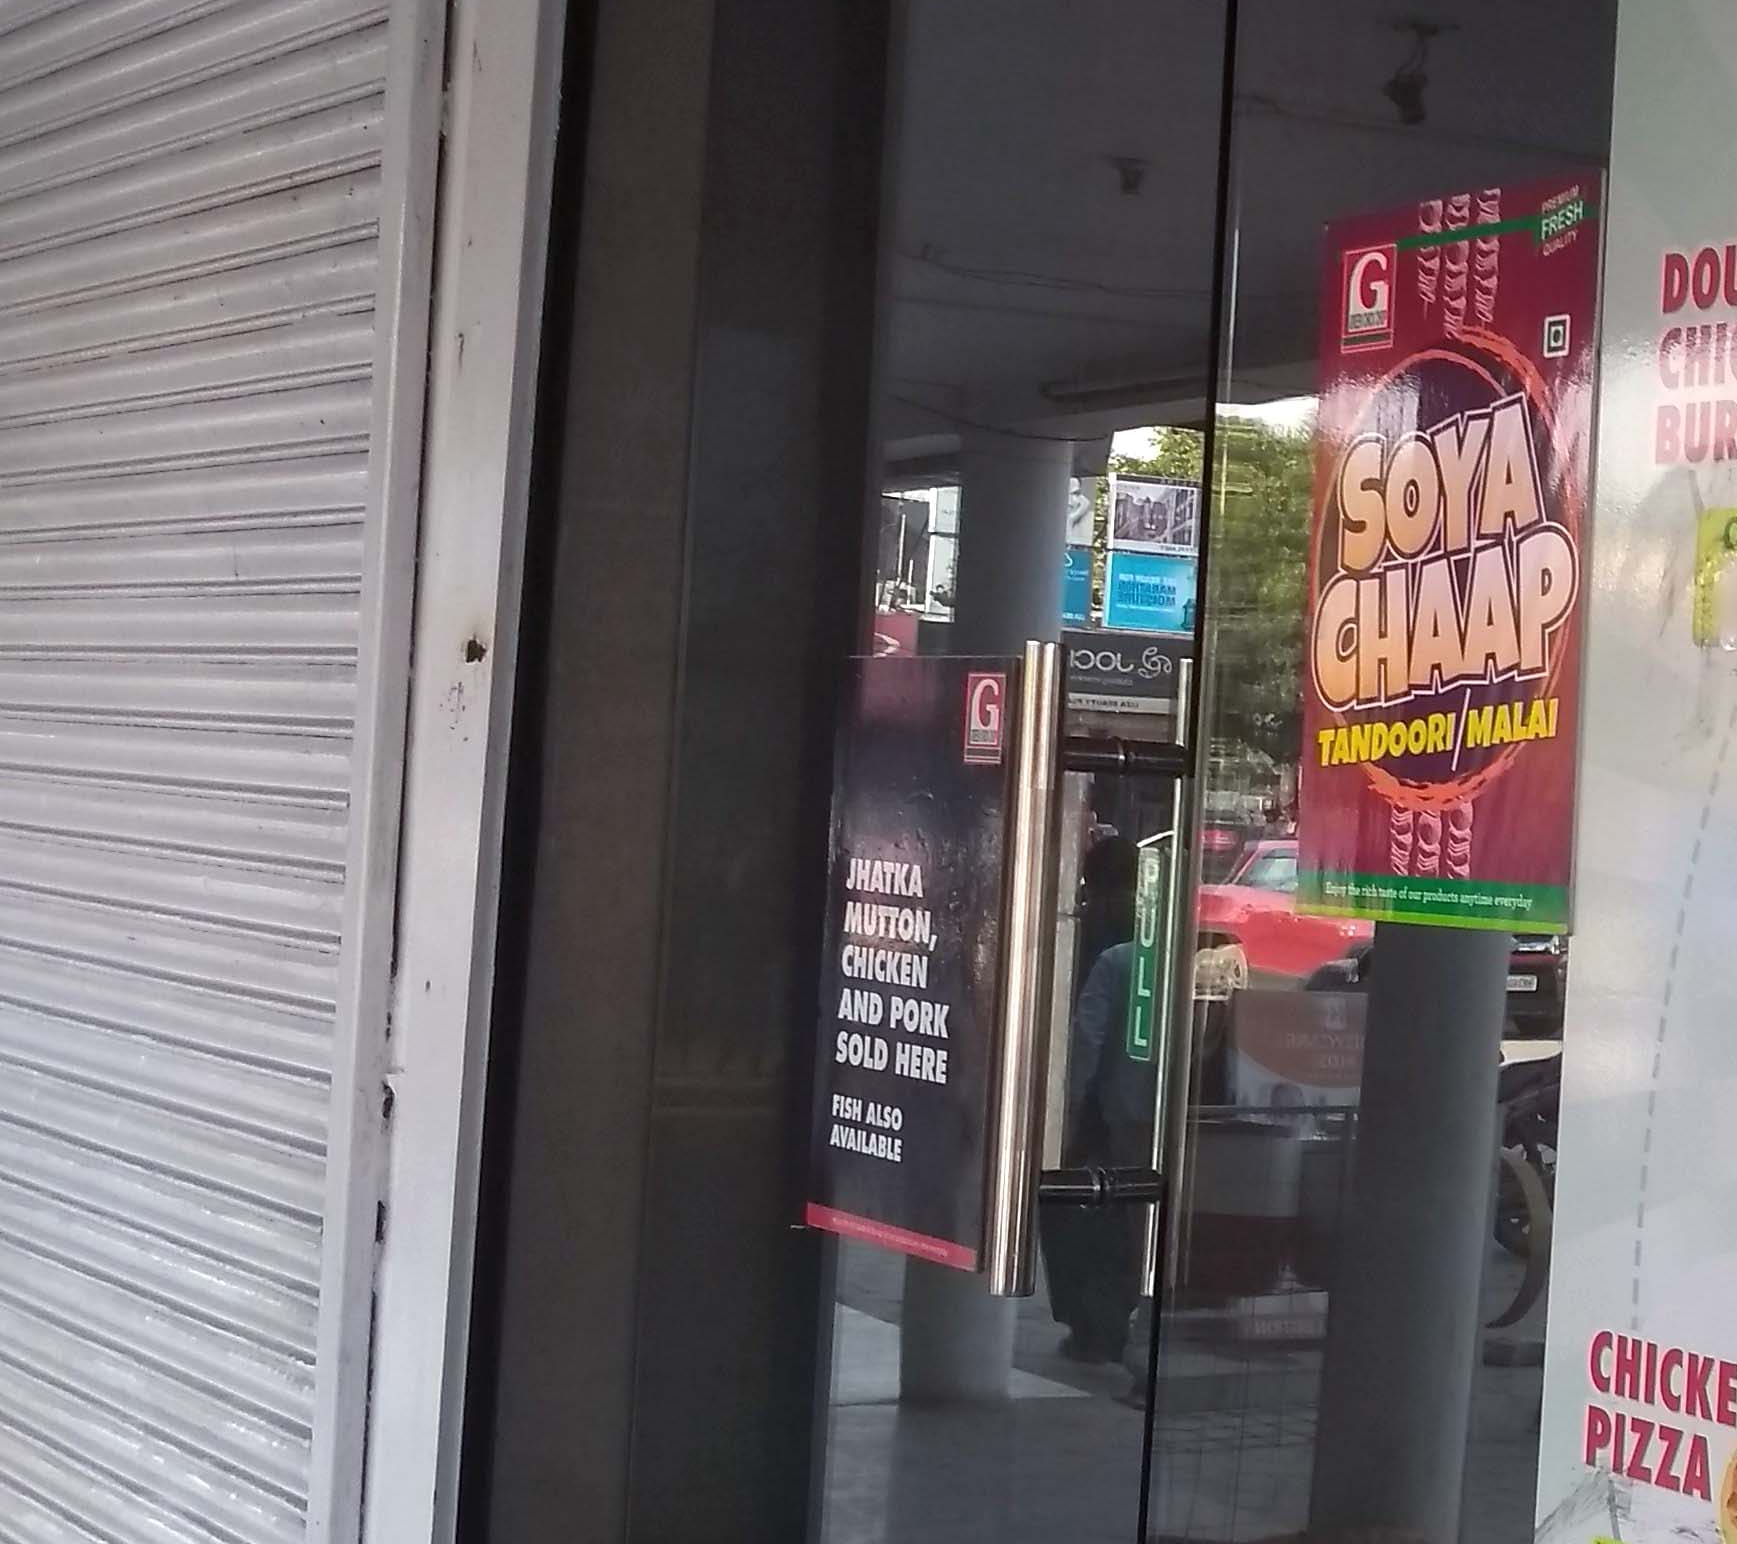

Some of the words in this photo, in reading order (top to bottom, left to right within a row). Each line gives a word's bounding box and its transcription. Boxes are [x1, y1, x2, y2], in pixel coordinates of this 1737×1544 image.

[1541, 200, 1584, 241] FRESH
[1336, 391, 1548, 574] SOYA
[1312, 521, 1580, 713] CHAAP
[1317, 712, 1455, 768] TANDOORI
[1468, 698, 1560, 750] MALAI
[846, 857, 924, 898] JHATKA
[1347, 883, 1361, 895] the
[1361, 884, 1378, 897] rich
[1378, 887, 1398, 899] taste
[1399, 886, 1408, 900] of
[1408, 890, 1423, 900] our
[1423, 888, 1459, 904] products
[1460, 893, 1494, 907] anytime
[1495, 894, 1534, 911] everyday
[843, 901, 938, 952] MUTTON,
[841, 944, 929, 989] CHICKEN
[1133, 858, 1158, 1048] PULL
[837, 987, 884, 1026] AND
[890, 995, 950, 1040] PORK
[835, 1030, 889, 1072] SOLD
[895, 1041, 949, 1085] HERE
[832, 1093, 863, 1123] FISH
[865, 1101, 904, 1132] ALSO
[829, 1123, 903, 1163] AVAILABLE
[1584, 1405, 1713, 1503] PIZZA
